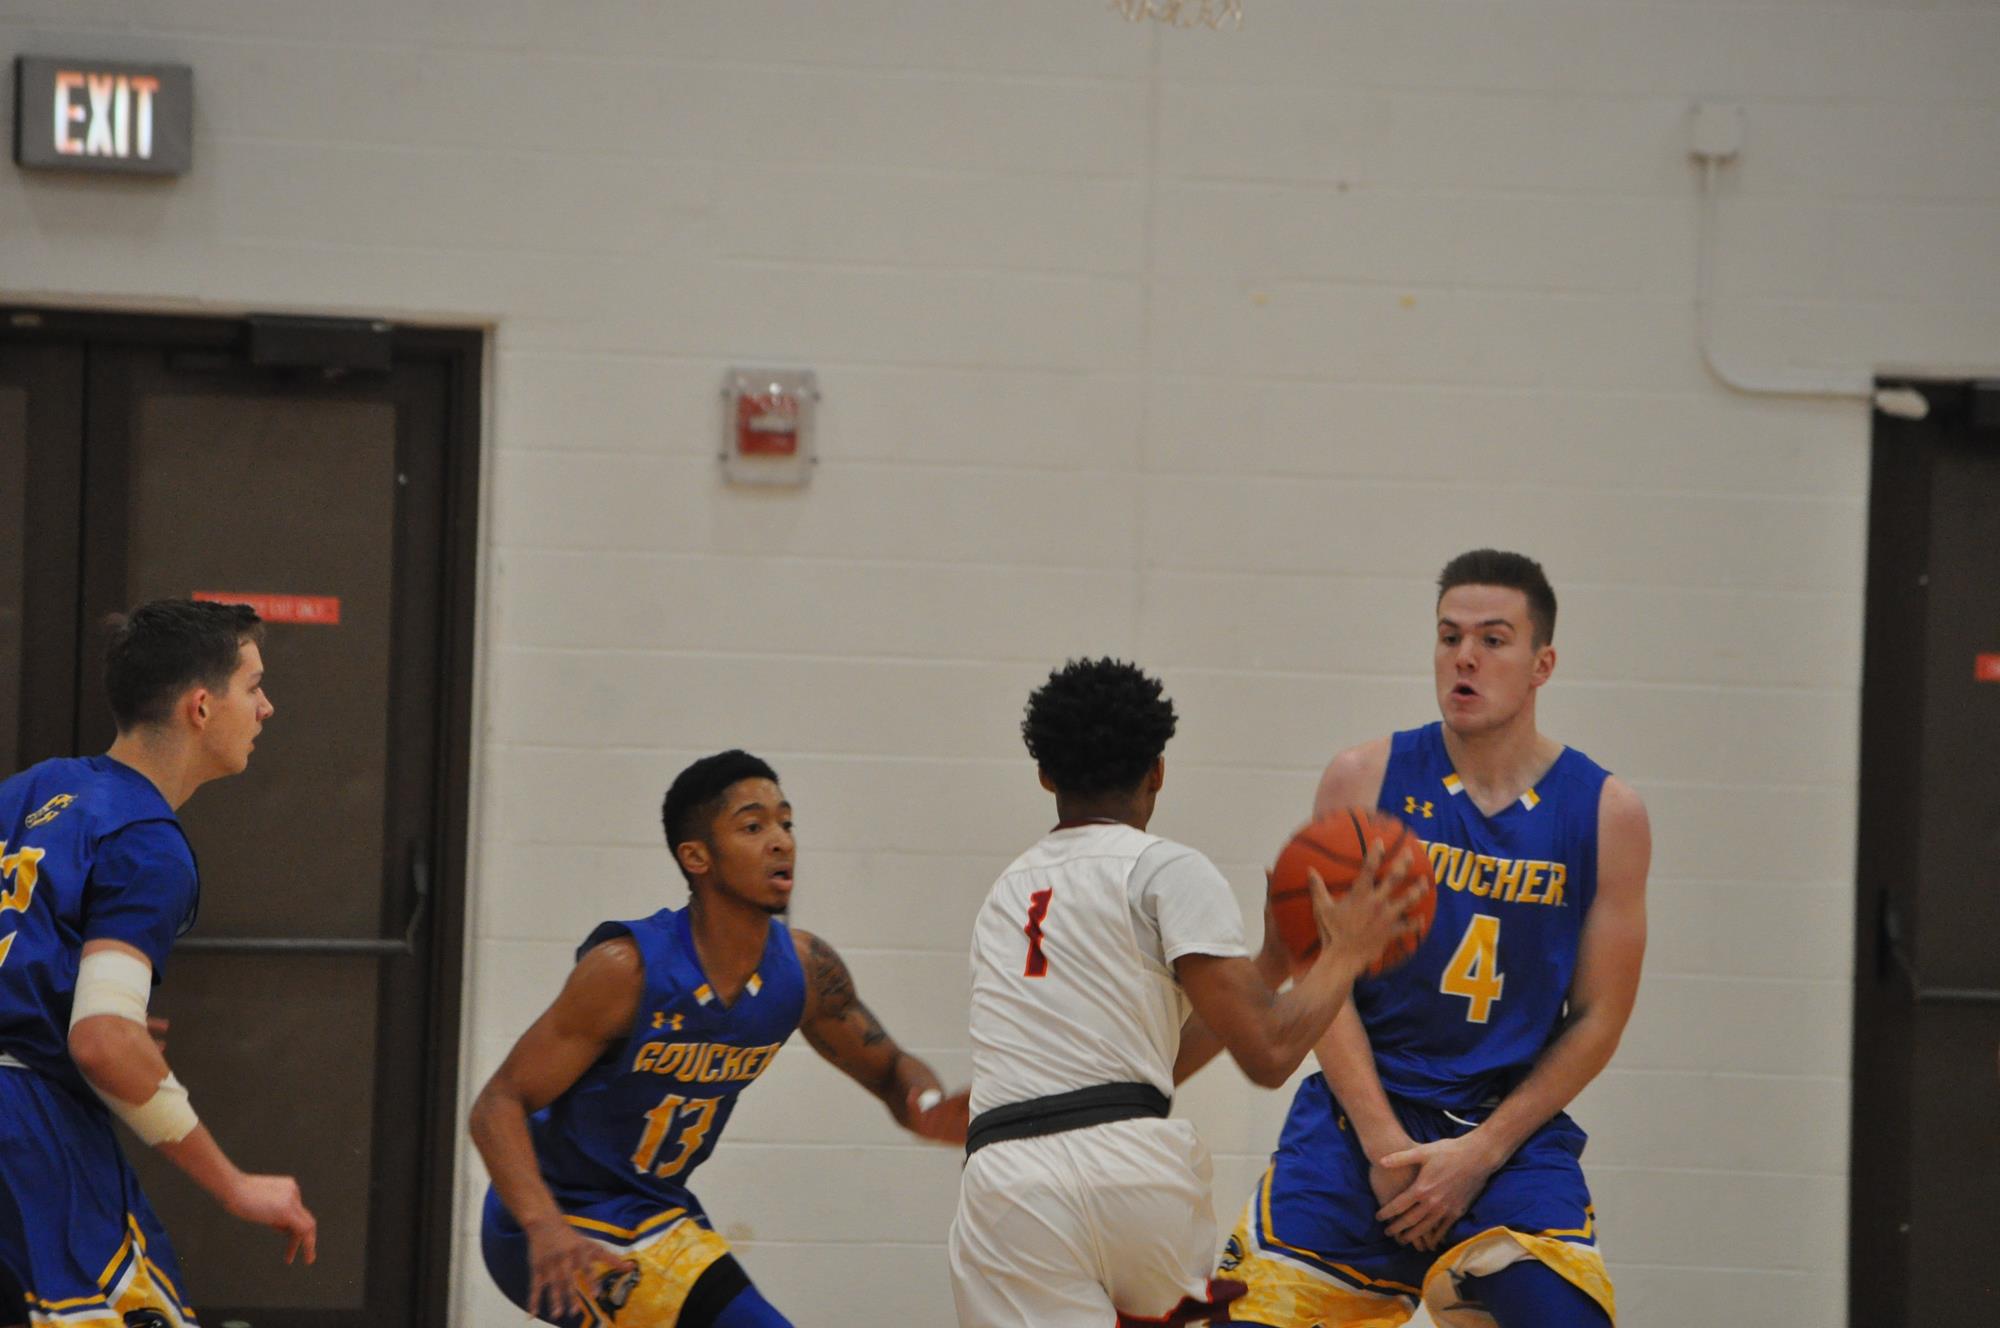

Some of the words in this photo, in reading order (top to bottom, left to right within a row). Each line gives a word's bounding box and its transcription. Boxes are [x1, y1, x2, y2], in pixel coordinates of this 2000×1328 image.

[54, 70, 160, 159] EXIT
[1417, 839, 1568, 907] OUCHER
[1023, 886, 1053, 978] 1
[1440, 913, 1504, 1024] 4
[630, 1093, 725, 1179] 13
